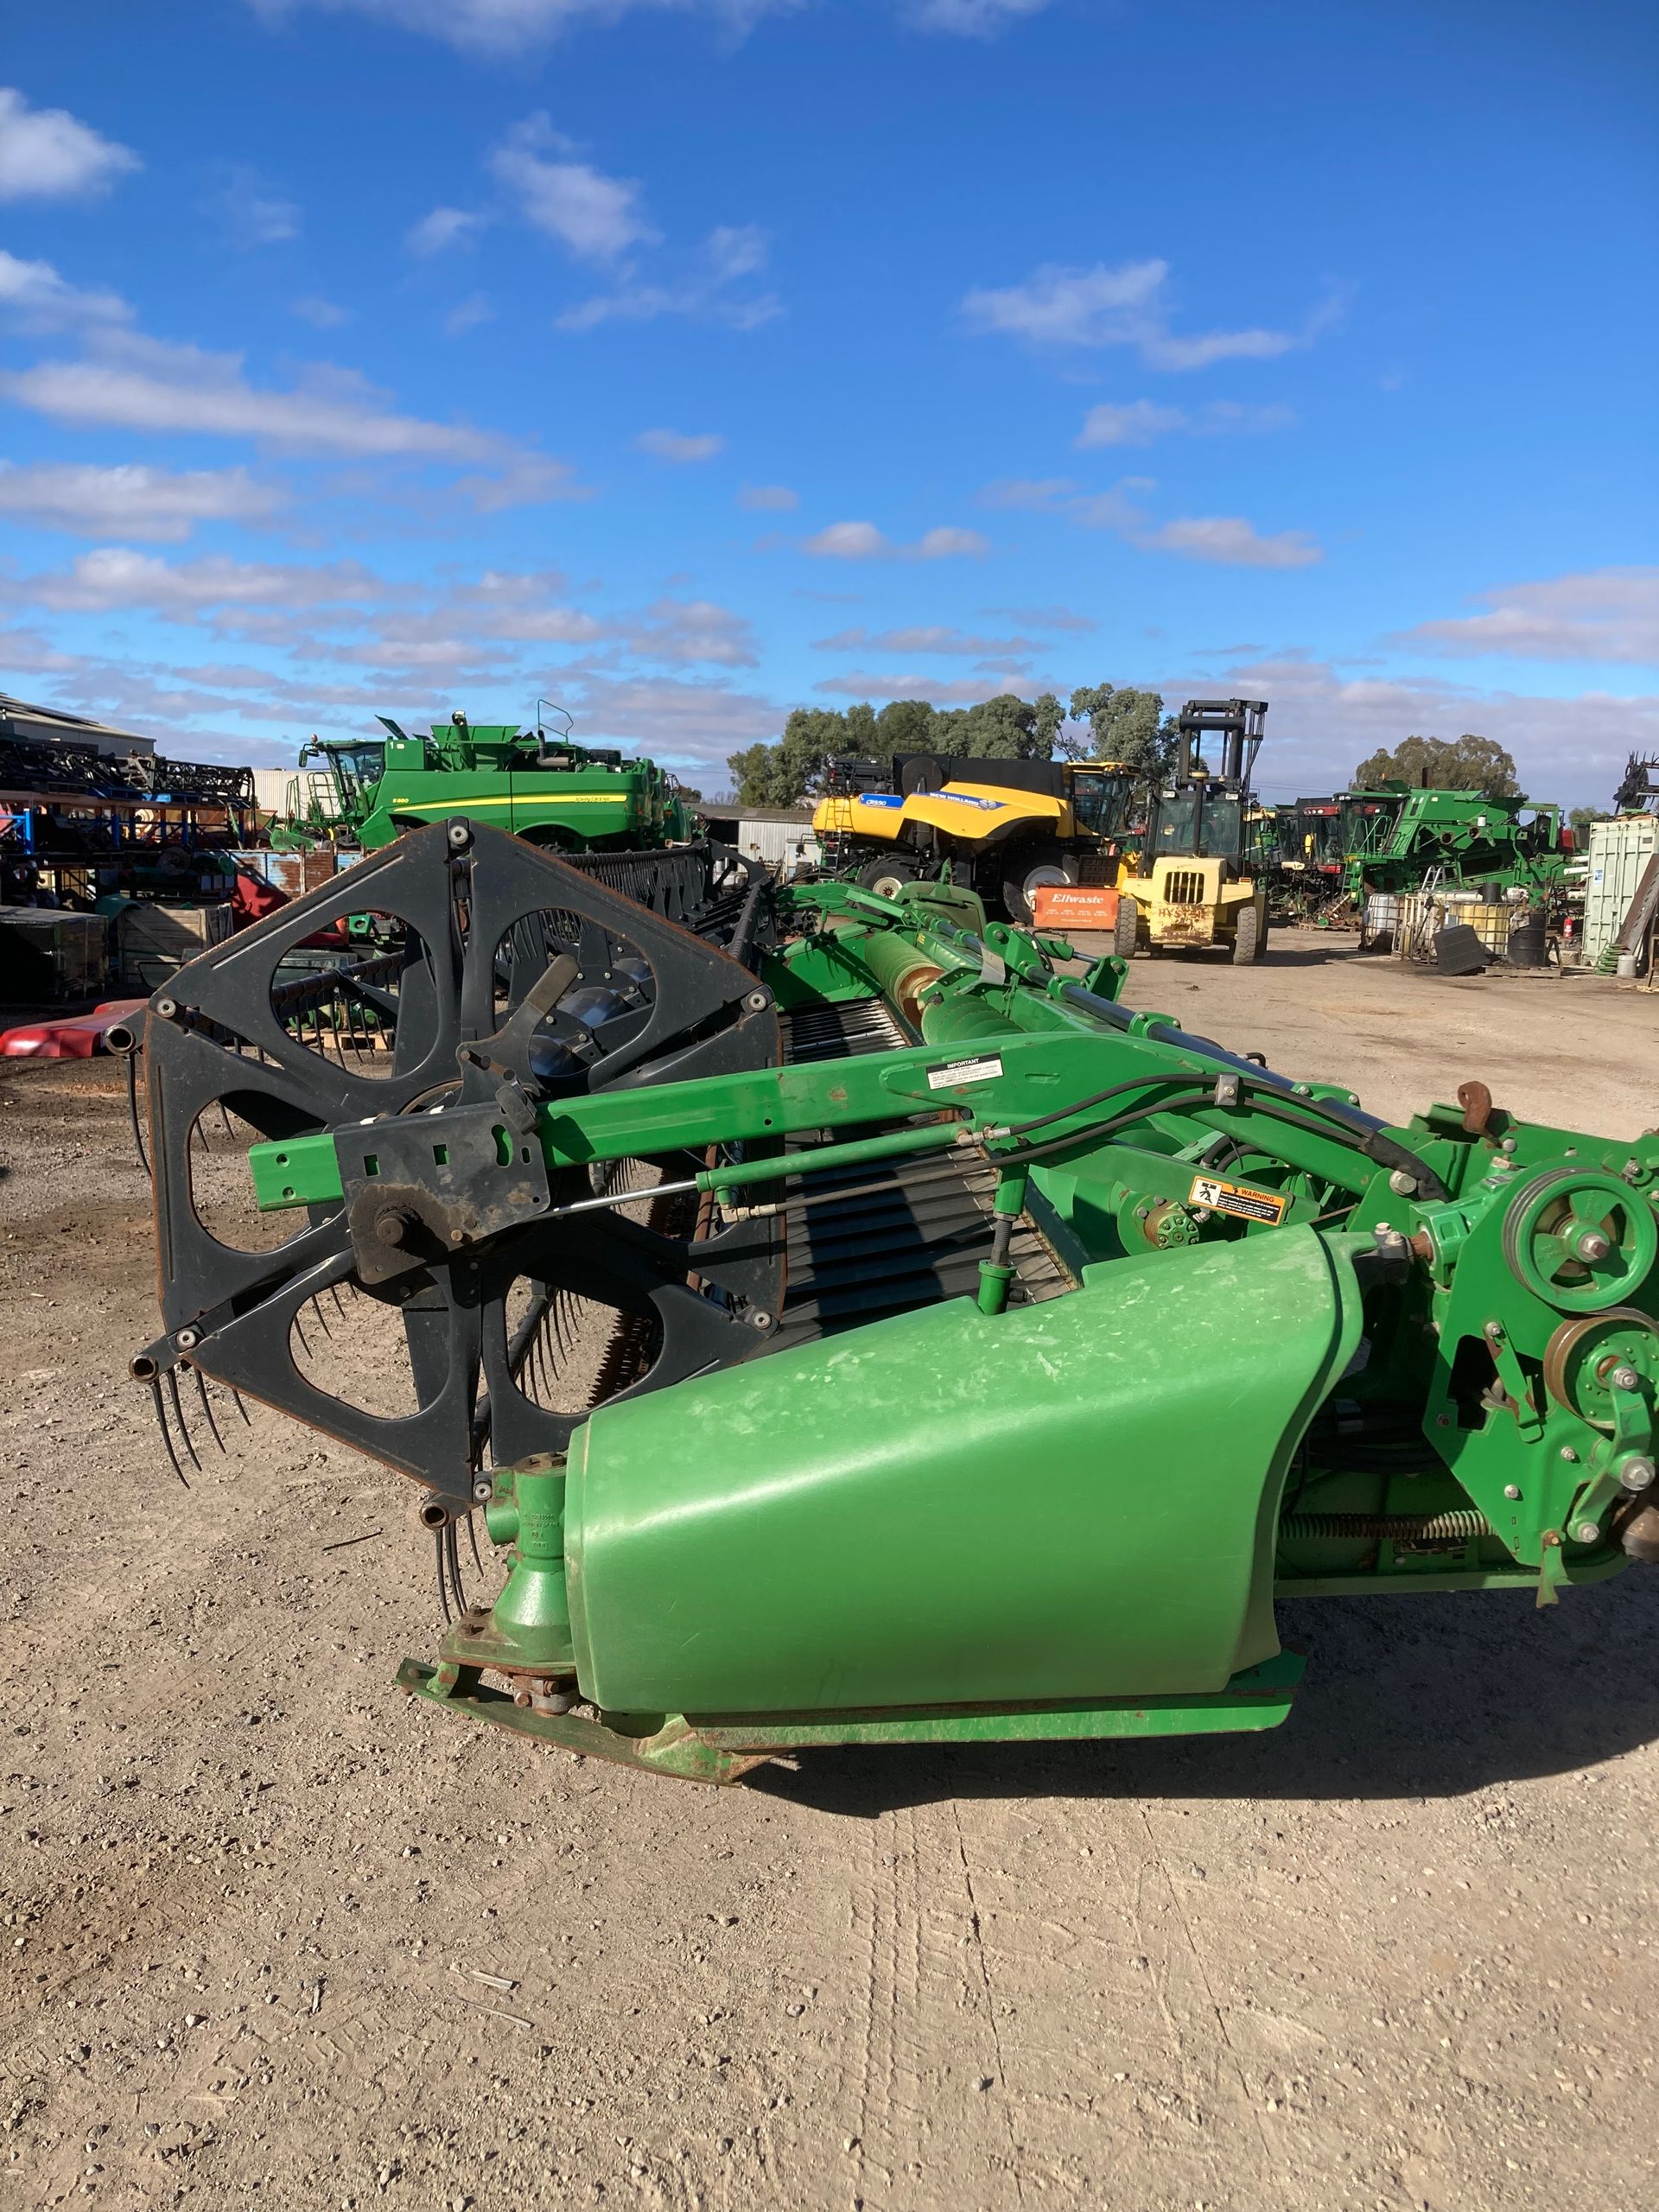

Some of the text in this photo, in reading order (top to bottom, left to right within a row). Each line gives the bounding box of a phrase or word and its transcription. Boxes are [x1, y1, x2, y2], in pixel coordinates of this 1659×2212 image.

[1052, 893, 1104, 904] Ellwaste
[946, 1058, 980, 1069] IMPORTANT
[1241, 1188, 1274, 1203] WARNING
